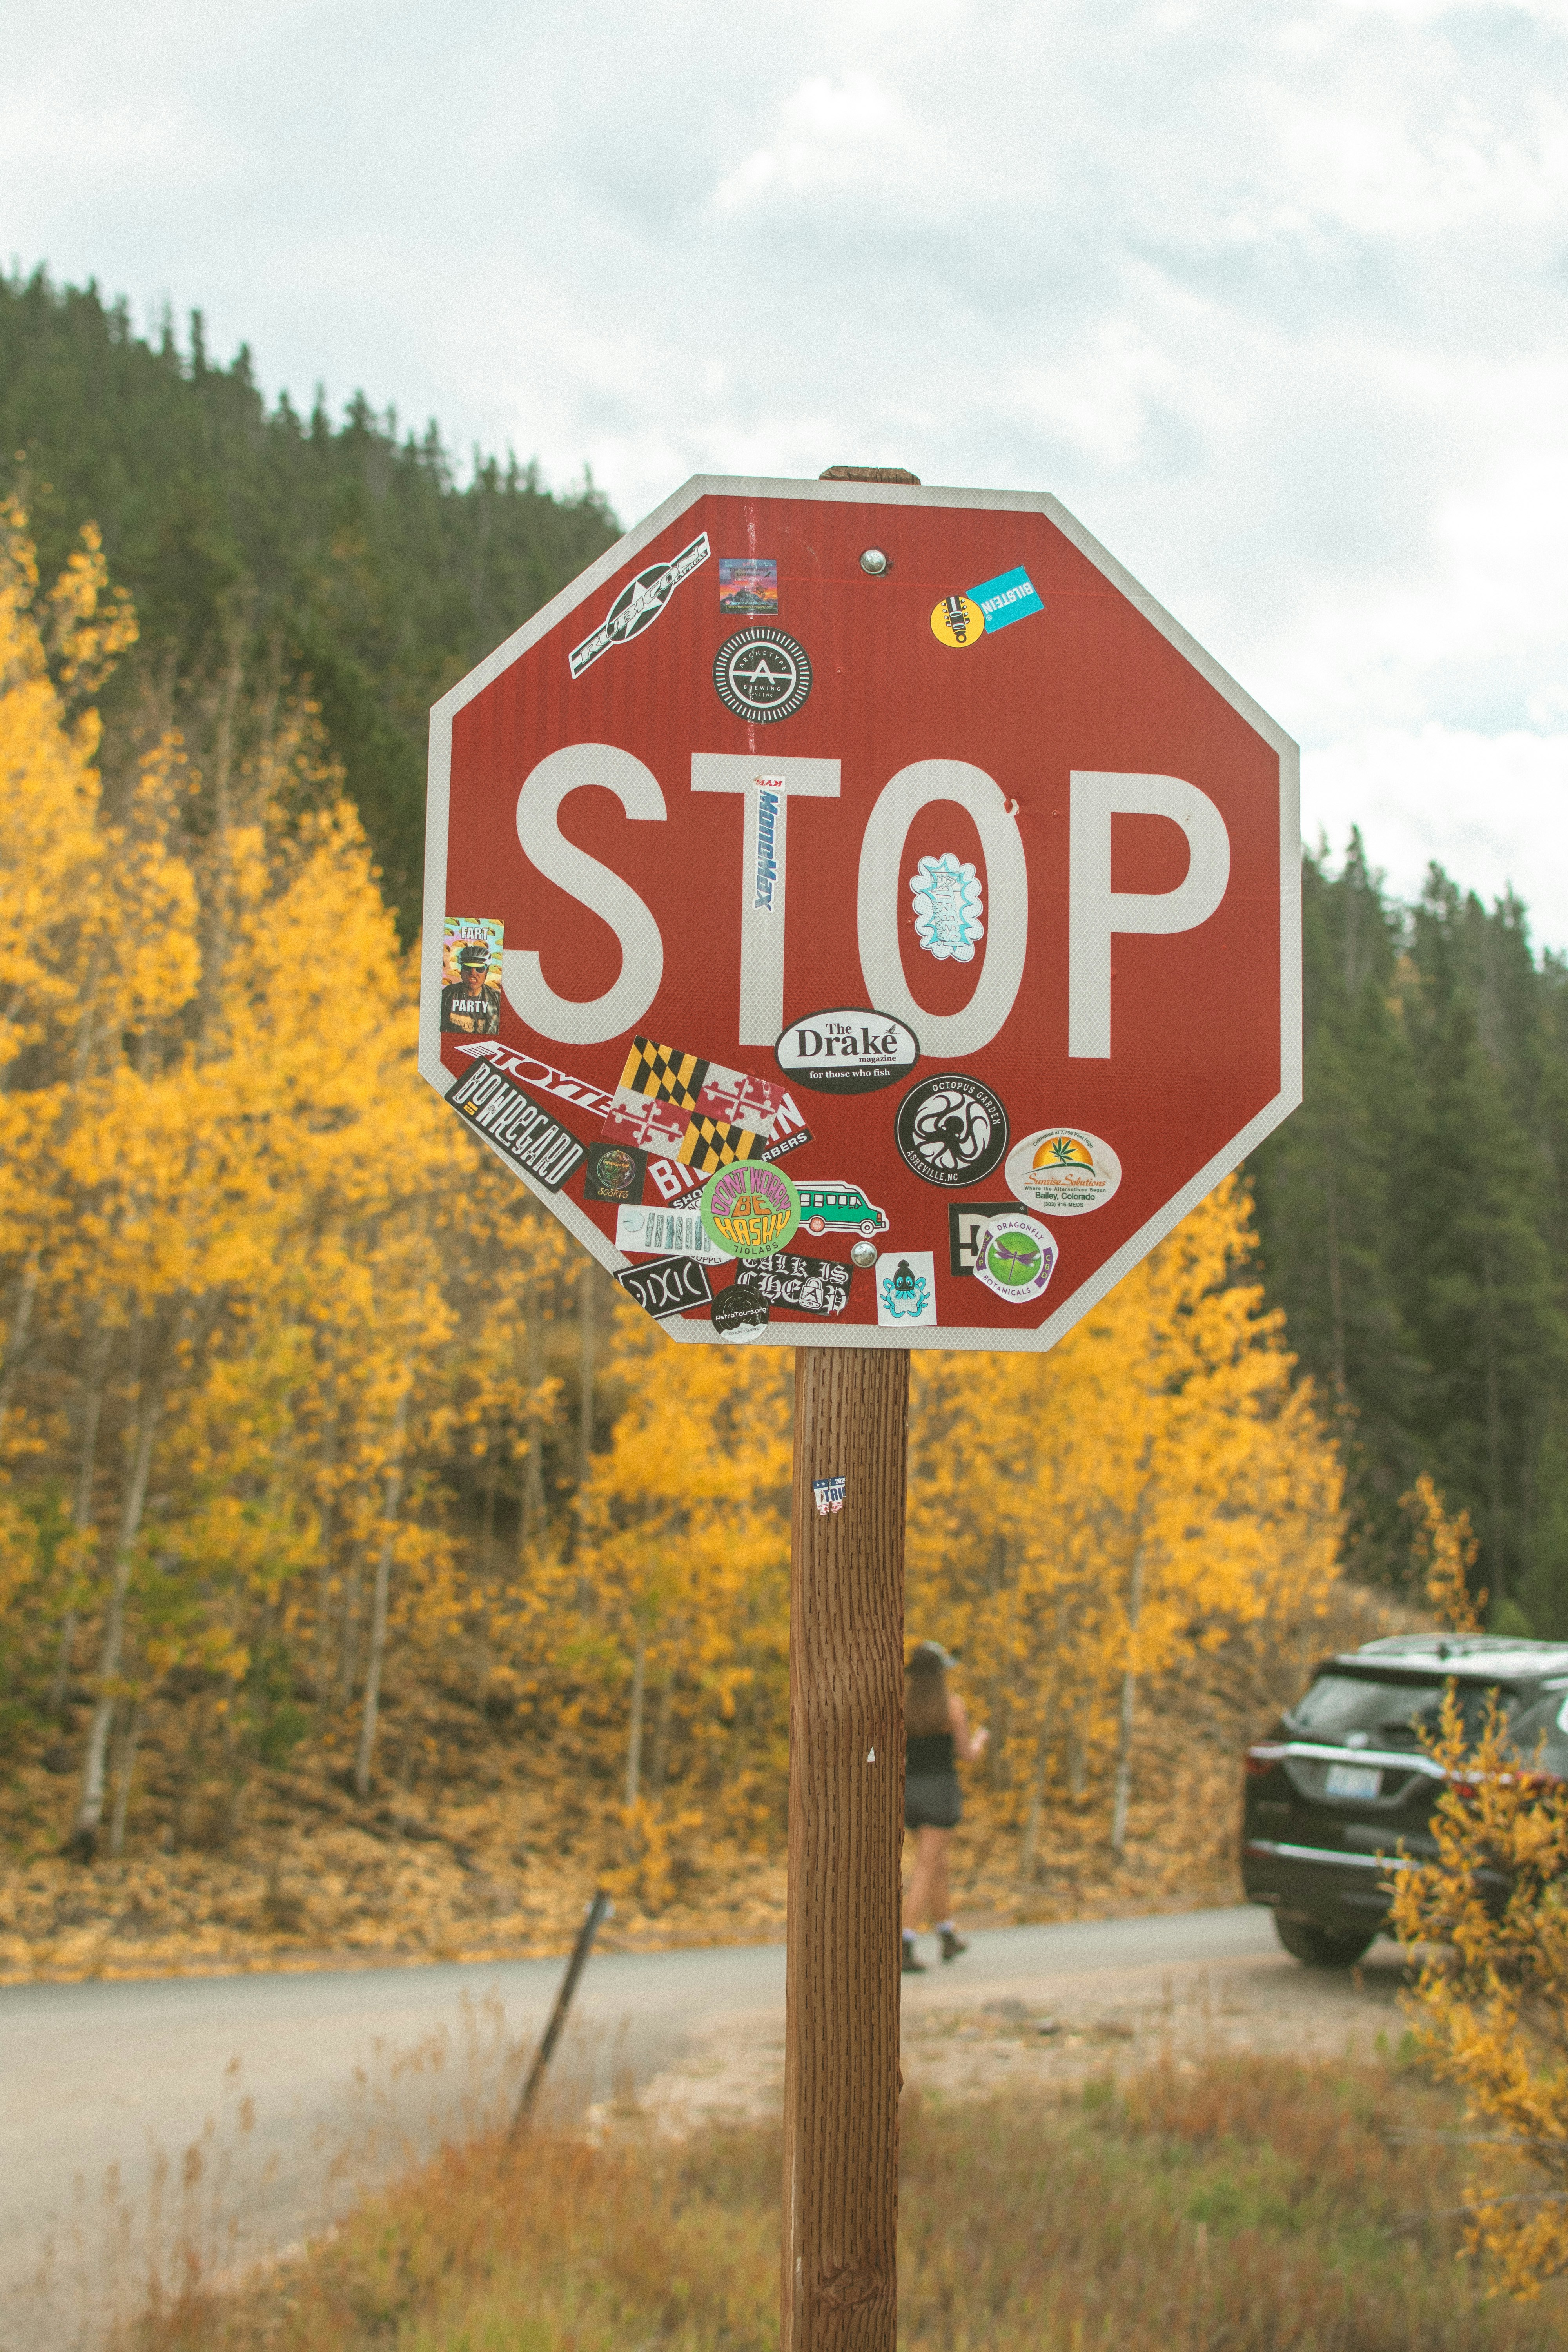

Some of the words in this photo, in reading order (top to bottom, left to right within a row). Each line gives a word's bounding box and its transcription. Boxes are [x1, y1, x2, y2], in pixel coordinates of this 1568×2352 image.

[580, 546, 699, 664] RUBICON
[981, 582, 1034, 615] BILSTEIN
[740, 651, 787, 670] ARCHETYPE
[503, 742, 1231, 1059] STOP
[461, 927, 490, 940] FART
[452, 999, 489, 1013] PARTY
[826, 1023, 852, 1034] The
[795, 1027, 898, 1057] Drake
[858, 1055, 897, 1063] magazine
[809, 1071, 824, 1079] for
[826, 1069, 850, 1078] those
[852, 1069, 871, 1077] who
[932, 1082, 975, 1093] OCTOPUS
[976, 1092, 1001, 1125] GARDEN
[1033, 1131, 1054, 1147] Cultivated
[1084, 1138, 1093, 1149] High
[749, 1166, 791, 1211] WORRY
[1024, 1173, 1062, 1185] Sunrise
[1061, 1174, 1106, 1187] Solutions
[1035, 1192, 1059, 1200] Bailey,
[731, 1195, 772, 1218] BE
[713, 1210, 791, 1246] HASHY
[996, 1221, 1044, 1240] DRAGONFLY
[818, 1262, 849, 1284] IS
[1041, 1254, 1051, 1279] CBD
[983, 1275, 1031, 1296] BOTANICALS
[715, 1307, 767, 1321] AstroTours.org
